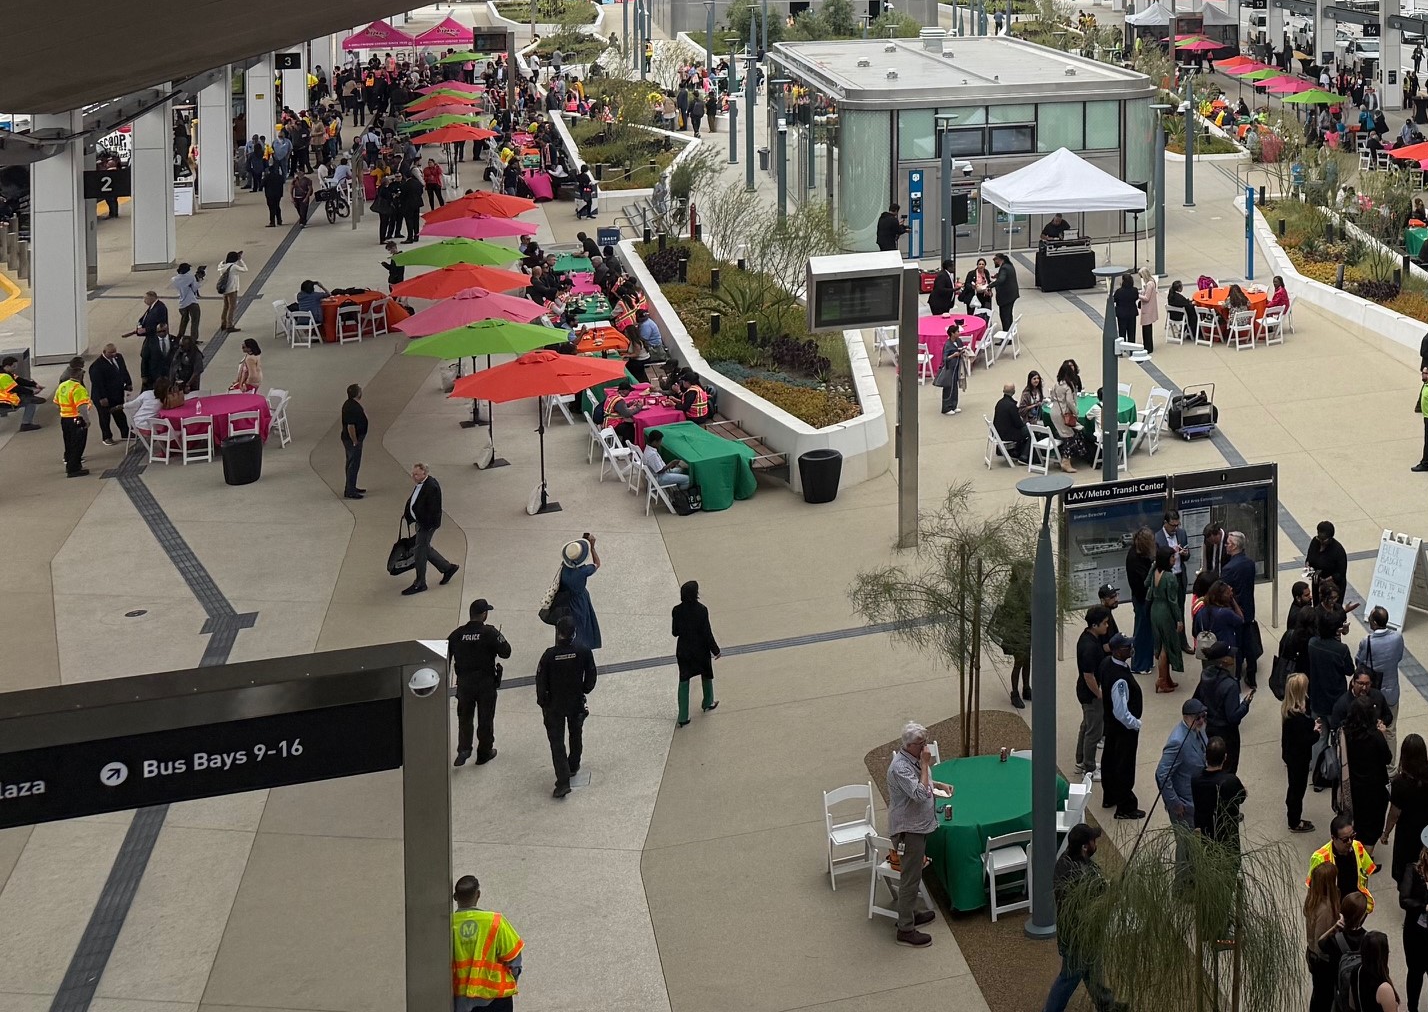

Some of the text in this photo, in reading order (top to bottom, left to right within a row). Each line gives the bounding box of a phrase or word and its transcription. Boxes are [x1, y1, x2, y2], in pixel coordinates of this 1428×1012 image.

[1256, 0, 1264, 8] 13
[1367, 26, 1376, 34] 14
[284, 56, 292, 66] 3
[101, 176, 113, 192] 2
[1067, 482, 1165, 501] LAX/Metro Transit Center
[1382, 544, 1401, 557] BLUE
[1378, 564, 1397, 576] ONLY
[462, 633, 480, 641] POLICE
[143, 739, 304, 778] Bus Bays 9-16
[0, 780, 46, 800] laza
[462, 922, 476, 936] M
